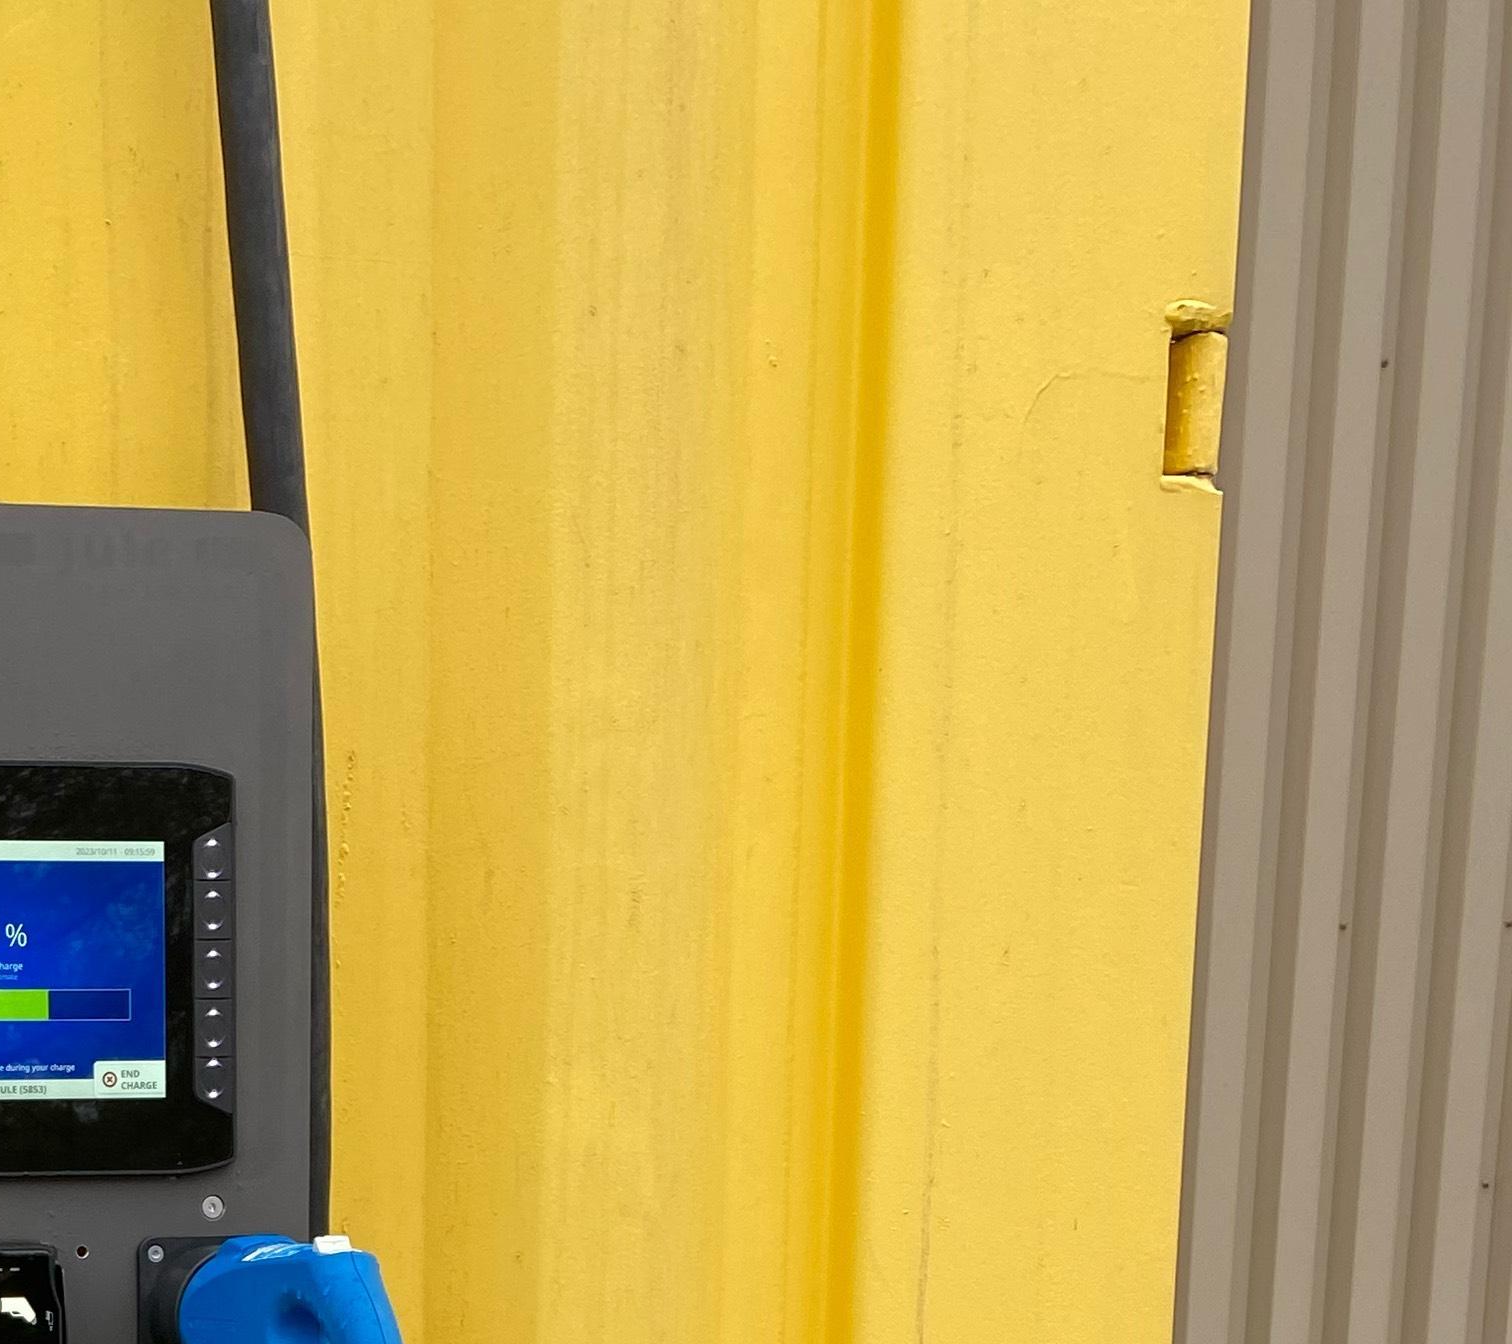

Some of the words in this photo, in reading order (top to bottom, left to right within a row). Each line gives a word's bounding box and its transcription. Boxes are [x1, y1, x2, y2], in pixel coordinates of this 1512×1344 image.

[5, 923, 28, 948] %
[5, 1063, 31, 1074] during
[31, 1064, 48, 1074] your
[49, 1063, 76, 1074] charge
[120, 1069, 141, 1079] END
[19, 1084, 48, 1096] (5853)
[120, 1081, 158, 1090] CHARGE
